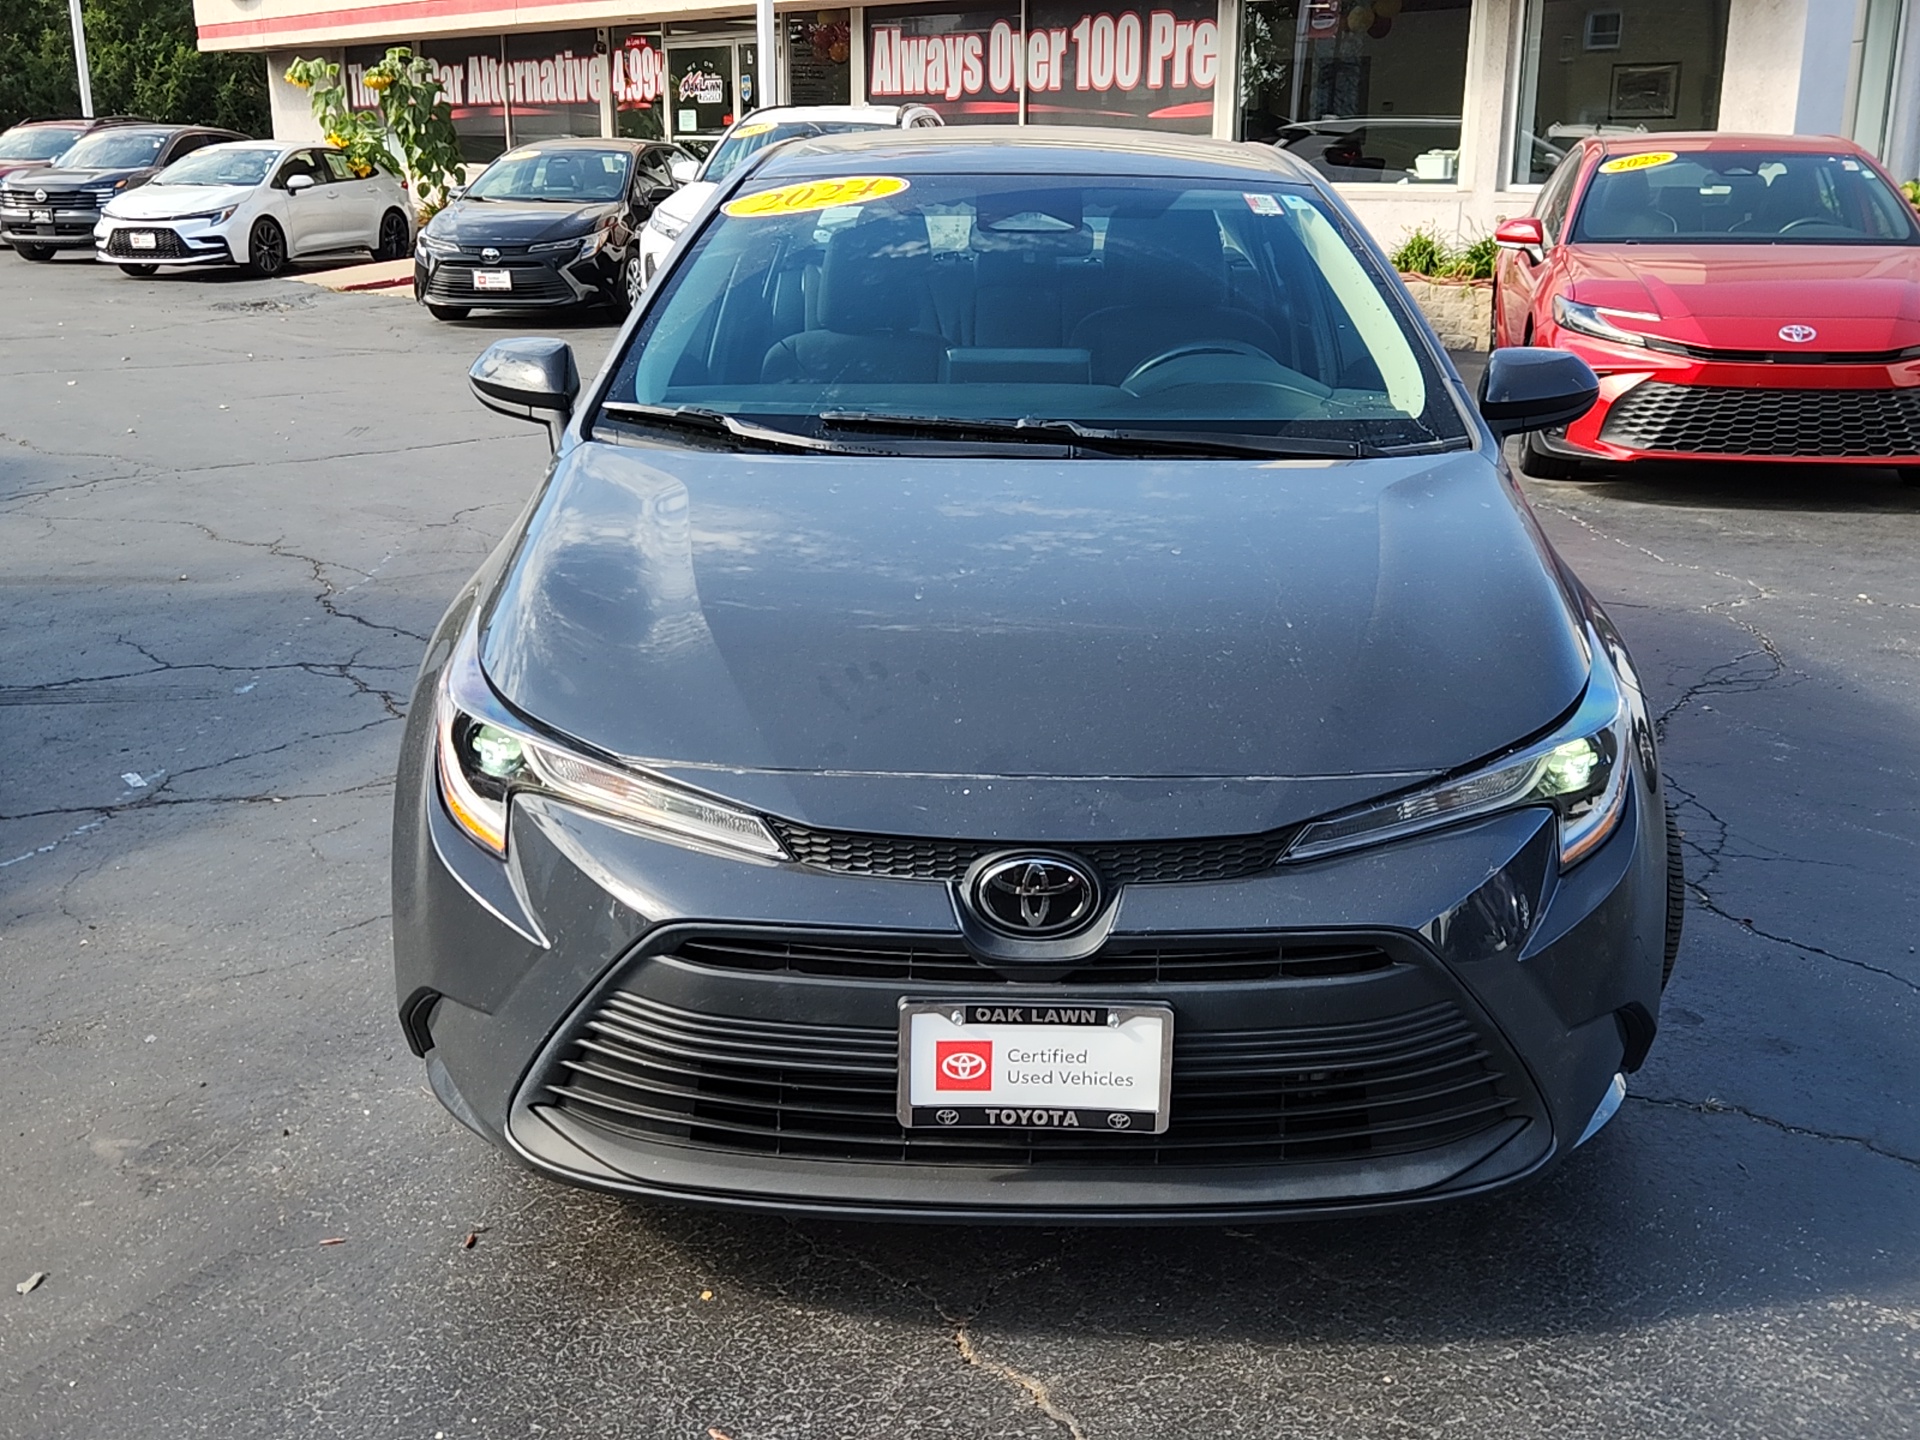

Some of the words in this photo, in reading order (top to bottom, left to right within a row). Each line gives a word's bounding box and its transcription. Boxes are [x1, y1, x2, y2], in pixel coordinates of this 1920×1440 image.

[872, 28, 982, 99] Always
[989, 20, 1066, 93] Over
[1073, 13, 1141, 91] 100
[1149, 11, 1218, 88] Pre
[468, 51, 601, 105] Alternative
[1610, 155, 1661, 170] 2025
[751, 179, 881, 213] 2024
[976, 1007, 1023, 1022] OAK
[1031, 1008, 1096, 1023] LAWN
[1007, 1048, 1088, 1064] Certified
[1007, 1069, 1053, 1085] Used
[1058, 1070, 1134, 1087] Vehicles
[985, 1109, 1079, 1127] TOYOTA
